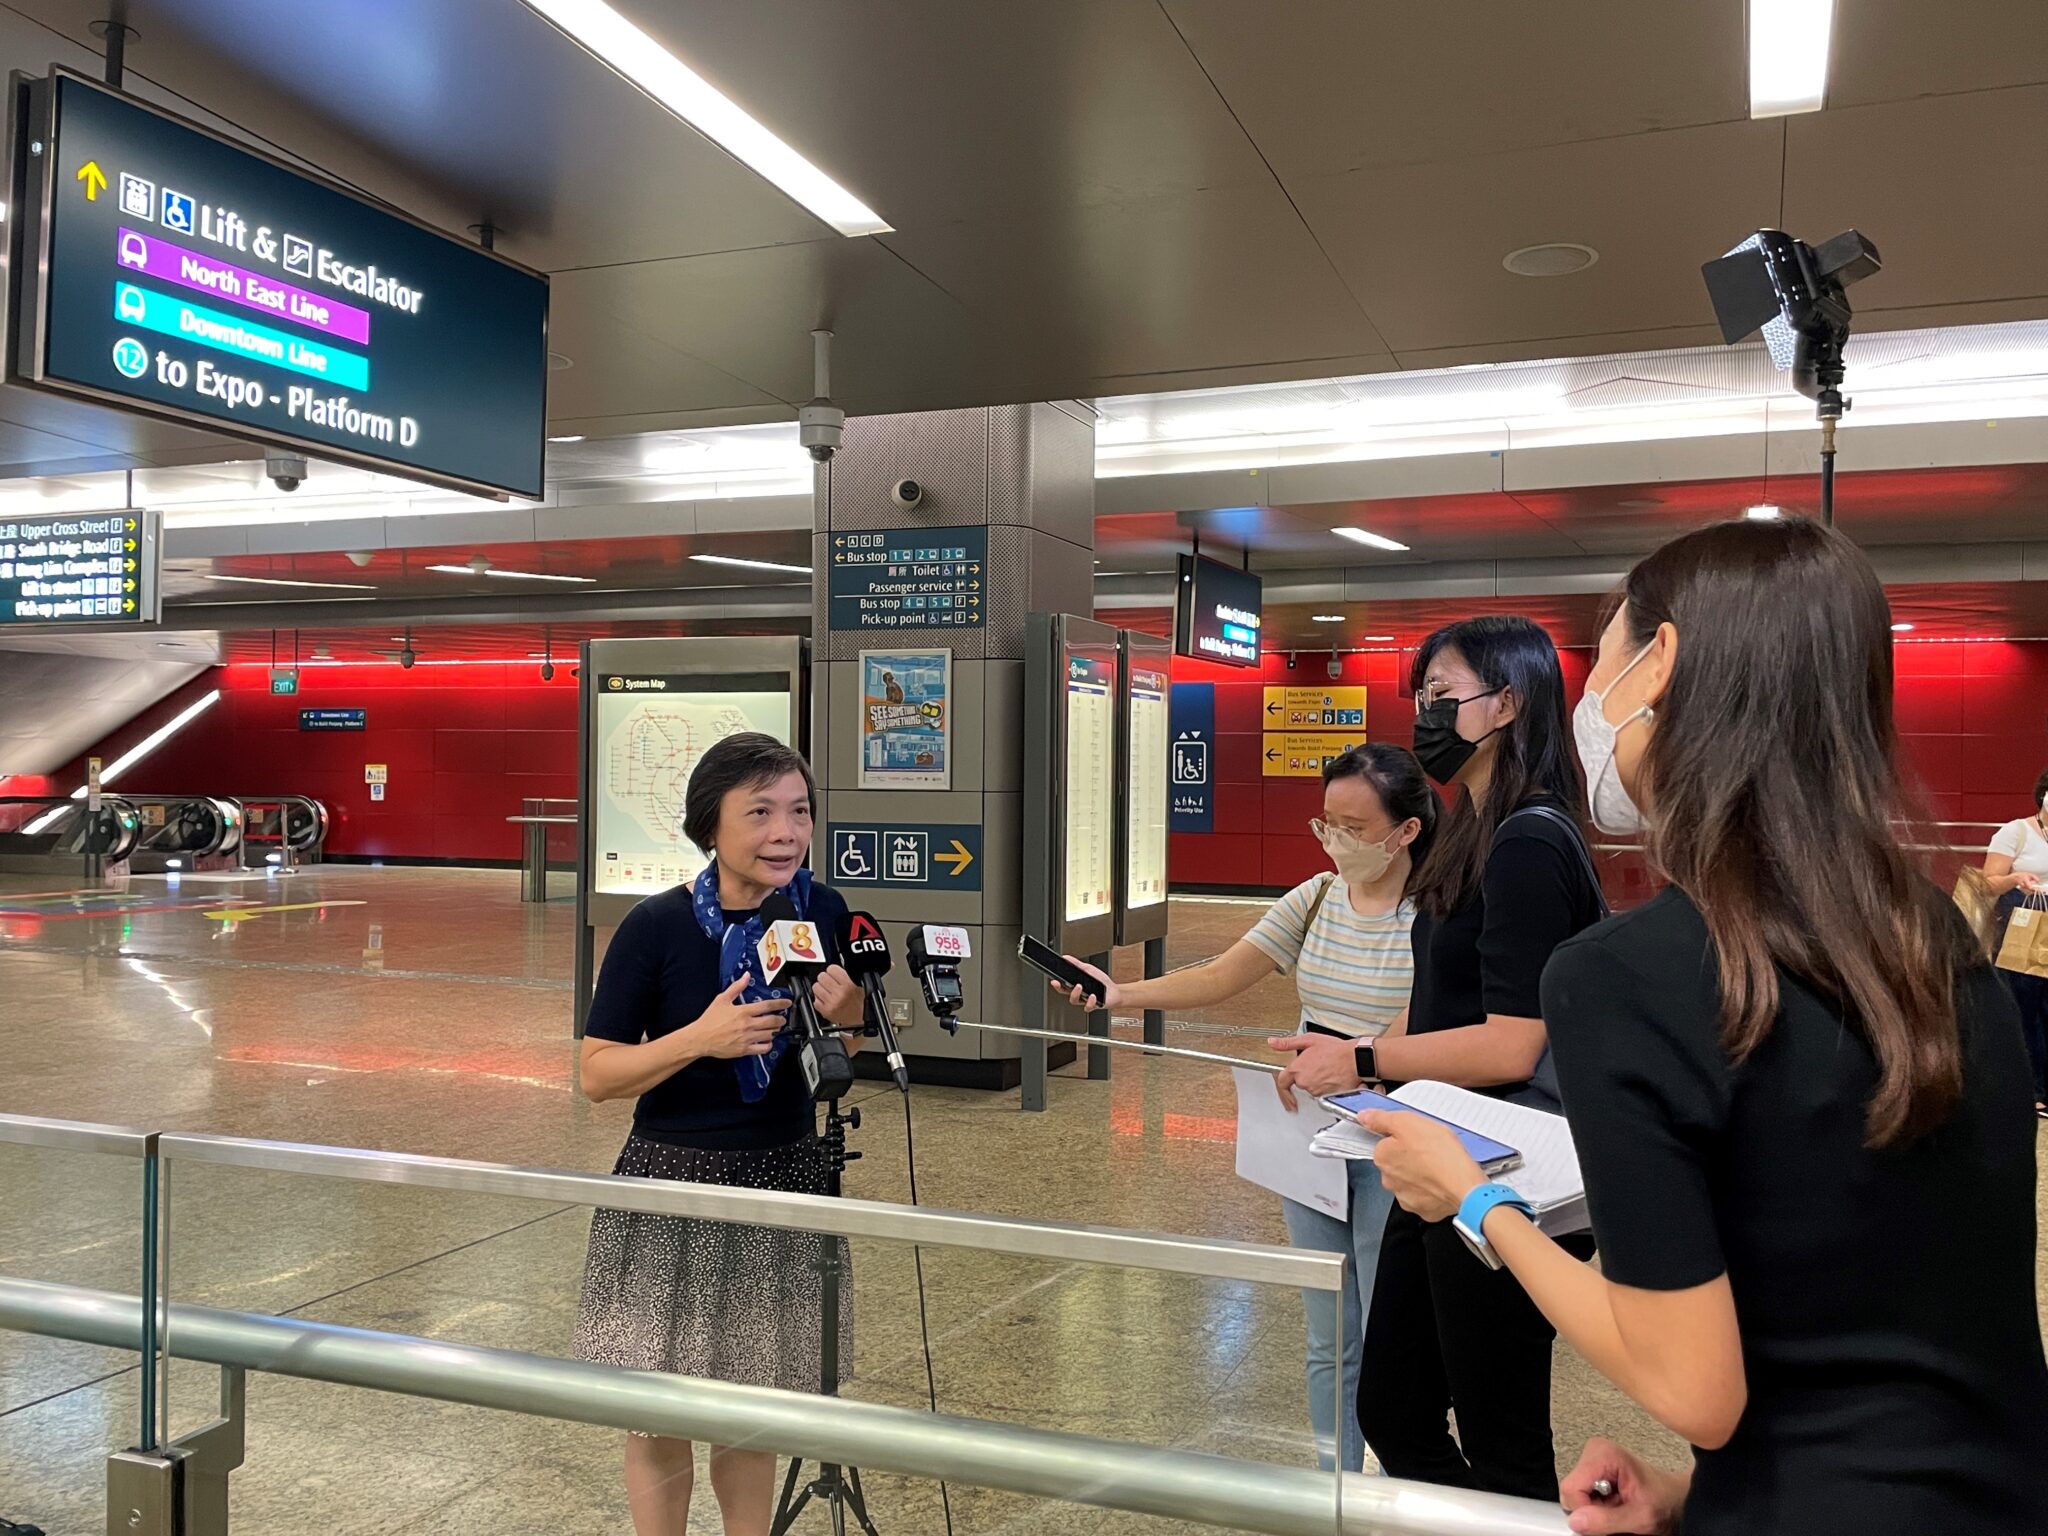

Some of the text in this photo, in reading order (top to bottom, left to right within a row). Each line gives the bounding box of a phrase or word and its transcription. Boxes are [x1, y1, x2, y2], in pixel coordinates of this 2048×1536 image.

[200, 205, 424, 315] Lift & Escalator
[180, 257, 330, 326] North East Line
[179, 308, 327, 373] Downtown Line
[119, 346, 142, 371] 12
[155, 351, 187, 389] to
[195, 360, 263, 410] Expo
[287, 385, 391, 446] Platform
[399, 416, 418, 449] D
[20, 524, 51, 540] Upper
[52, 521, 79, 535] Cross
[79, 519, 109, 534] Street
[848, 552, 865, 563] Bus
[866, 551, 888, 564] stop
[912, 564, 940, 576] Toilet
[868, 580, 952, 594] Passenger service
[860, 599, 878, 610] Bus
[880, 598, 900, 610] stop
[862, 613, 897, 626] Pick-up
[900, 612, 926, 626] point
[274, 682, 289, 692] EXIT
[626, 678, 666, 690] System Map
[870, 706, 888, 720] SEE
[1324, 714, 1346, 724] D 3
[790, 923, 813, 951] 8
[935, 936, 961, 950] 958
[850, 938, 886, 954] cna
